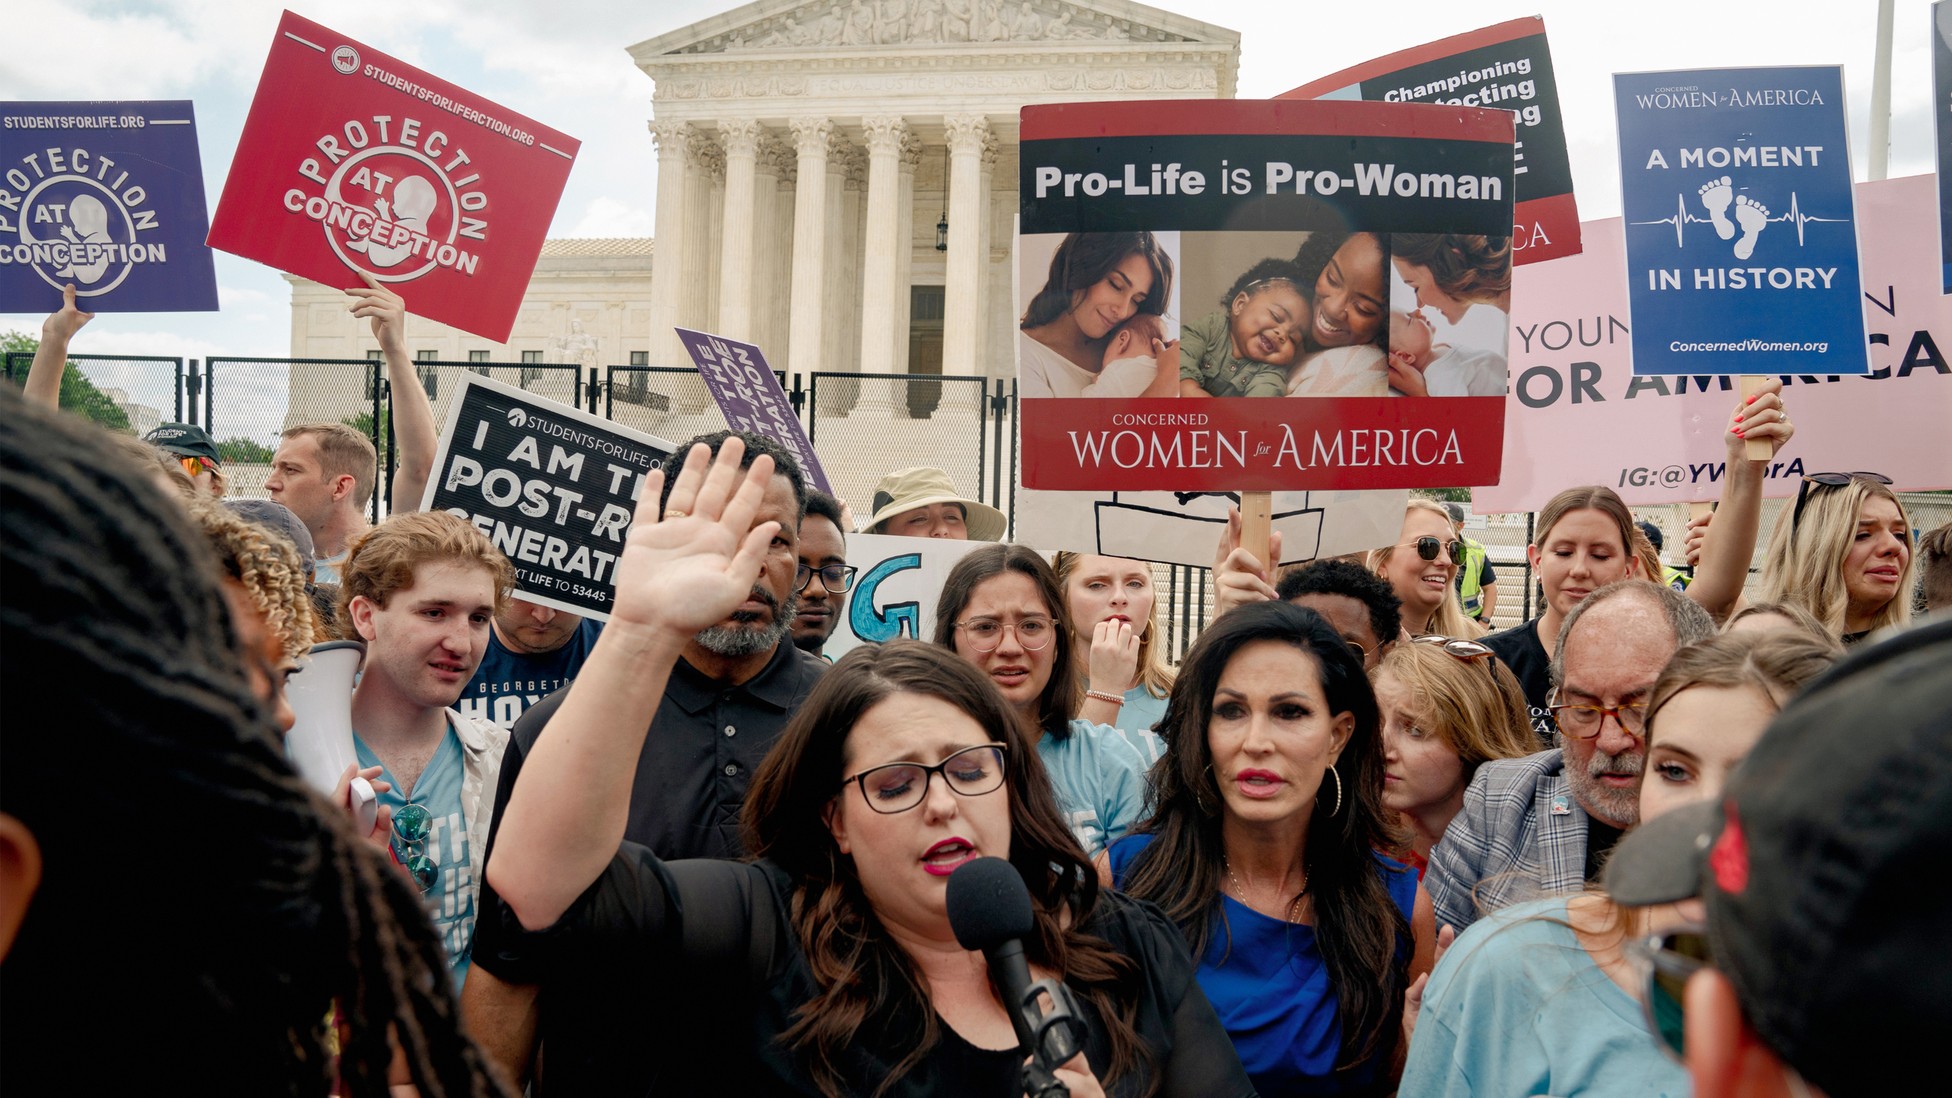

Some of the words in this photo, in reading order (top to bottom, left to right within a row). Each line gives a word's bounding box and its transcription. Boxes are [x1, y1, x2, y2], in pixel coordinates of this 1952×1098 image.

[1384, 58, 1532, 103] Championing
[1636, 91, 1718, 110] WOMEN
[1729, 88, 1825, 108] AMERICA
[4, 116, 145, 129] STUDENTSFORLIFE.ORG
[363, 63, 536, 147] STUDENTSFORLIFEACTION.ORG
[299, 115, 488, 241] PROTECTION
[1646, 149, 1669, 170] A
[1680, 146, 1824, 169] MOMENT
[350, 166, 393, 195] AT
[1035, 163, 1206, 198] Pro-Life
[1221, 160, 1252, 195] is
[1265, 162, 1502, 201] Pro-Woman
[35, 204, 65, 224] AT
[283, 188, 479, 276] CONCEPTION
[1648, 269, 1681, 290] IN
[1694, 267, 1838, 290] HISTORY
[1669, 339, 1829, 354] ConcernedWomen.org
[696, 344, 737, 401] THE
[1506, 361, 1607, 409] OR
[1112, 413, 1209, 426] CONCERNED
[472, 420, 490, 451] I
[507, 435, 585, 482] AM
[527, 416, 666, 471] STUDENTSFORLIFE.O
[1067, 429, 1248, 469] WOMEN
[1253, 441, 1271, 457] for
[1272, 423, 1464, 471] AMERICA
[445, 454, 633, 543] POST-R
[529, 572, 553, 587] LIFE
[555, 579, 570, 592] TO
[571, 584, 606, 602] 53445
